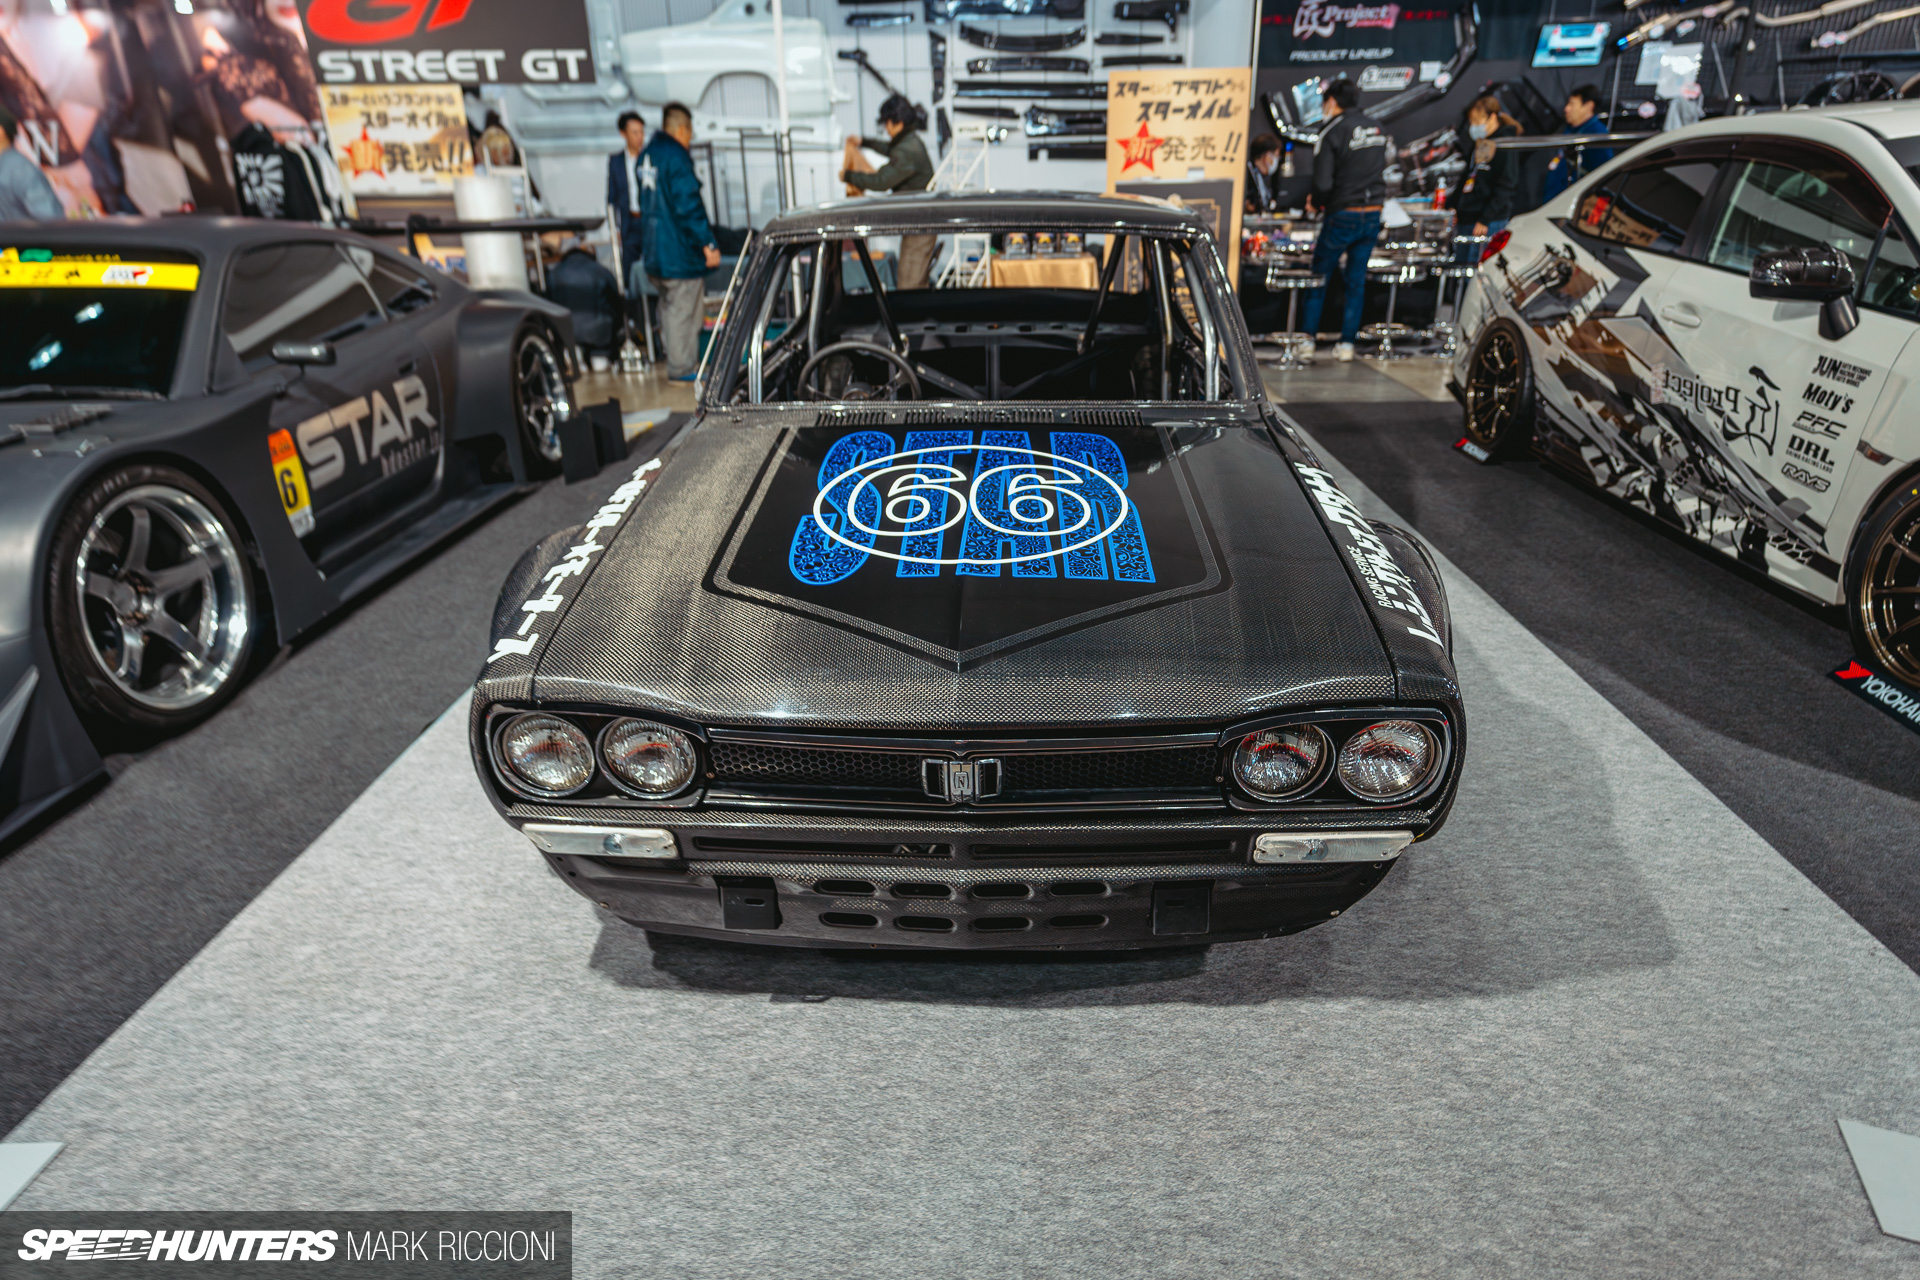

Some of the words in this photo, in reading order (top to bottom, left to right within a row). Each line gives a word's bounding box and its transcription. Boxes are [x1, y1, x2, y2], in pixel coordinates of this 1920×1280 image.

[317, 49, 505, 82] STREET
[521, 49, 587, 82] GT
[1812, 354, 1842, 380] JUN
[1802, 382, 1855, 414] Moty's
[296, 374, 437, 491] STAR
[1797, 410, 1848, 437] PFC
[1788, 434, 1835, 466] DRL
[279, 468, 299, 510] 6
[1781, 462, 1831, 493] RAYS
[788, 430, 1157, 585] STAR
[1346, 545, 1374, 577] SERVICE
[1366, 576, 1394, 609] RACING
